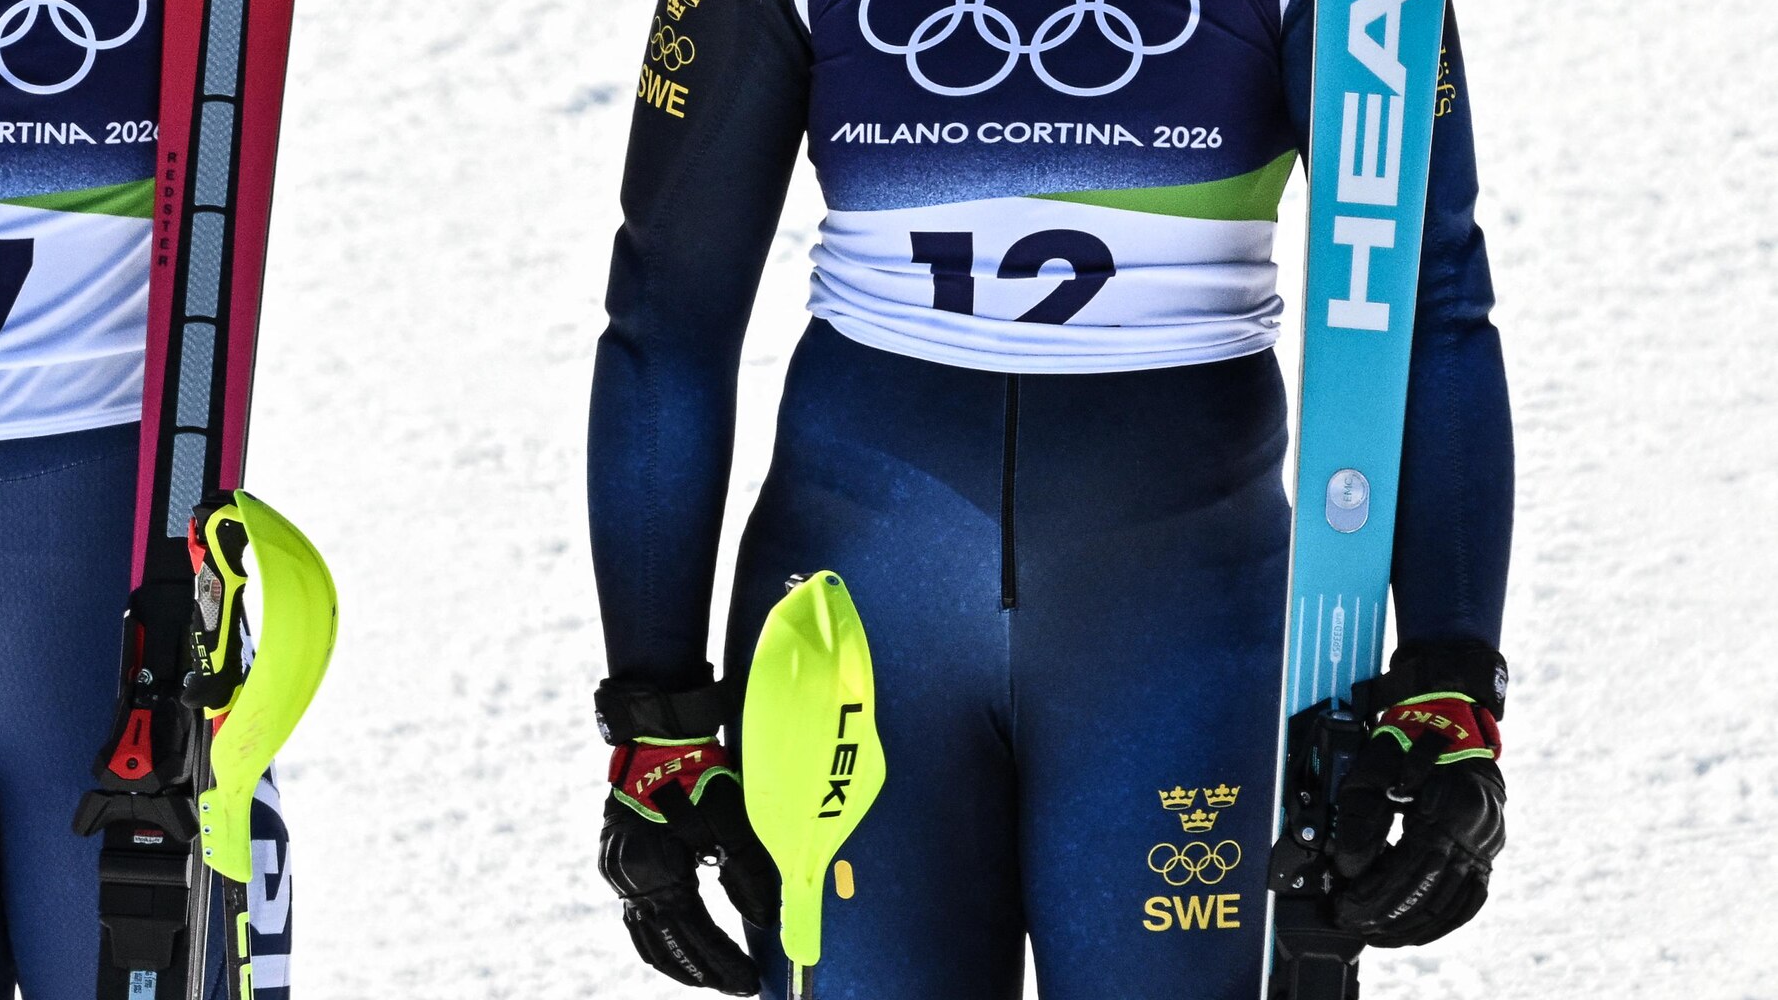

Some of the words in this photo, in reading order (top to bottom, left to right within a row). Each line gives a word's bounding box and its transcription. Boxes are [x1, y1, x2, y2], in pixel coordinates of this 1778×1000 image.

[637, 64, 689, 118] SWE
[830, 122, 969, 144] MILANO
[977, 122, 1144, 146] CORTINA
[1153, 126, 1222, 148] 2026
[157, 152, 178, 268] REDSTER
[910, 228, 1117, 326] 12
[194, 631, 211, 676] LEKI
[1398, 710, 1469, 740] LEKI
[635, 750, 703, 795] LEKI
[817, 703, 863, 818] LEKI
[1142, 893, 1241, 932] SWE
[1388, 870, 1441, 919] HESTRA
[661, 927, 704, 983] HESTRA
